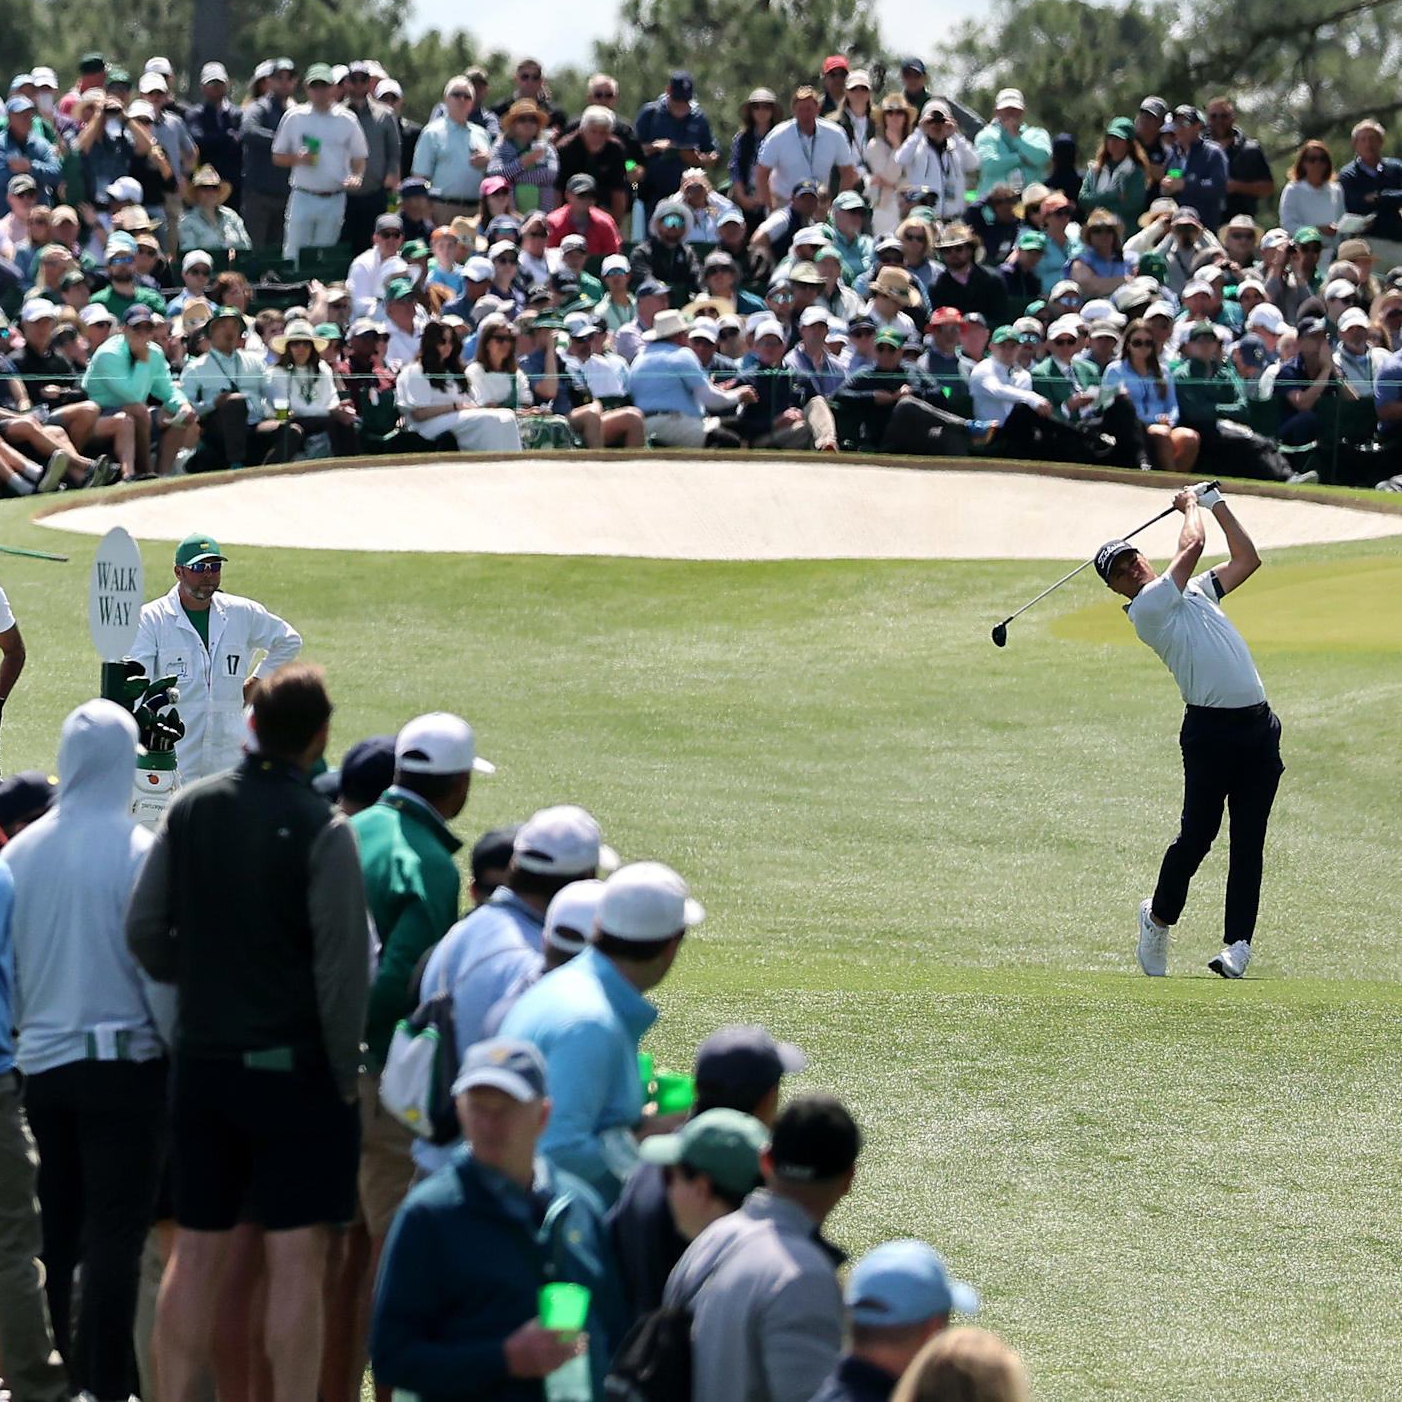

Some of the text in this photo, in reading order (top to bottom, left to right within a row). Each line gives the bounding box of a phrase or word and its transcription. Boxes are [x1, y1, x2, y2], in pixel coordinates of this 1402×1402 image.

[97, 561, 138, 592] WALK
[98, 595, 132, 626] WAY
[226, 653, 241, 676] 17
